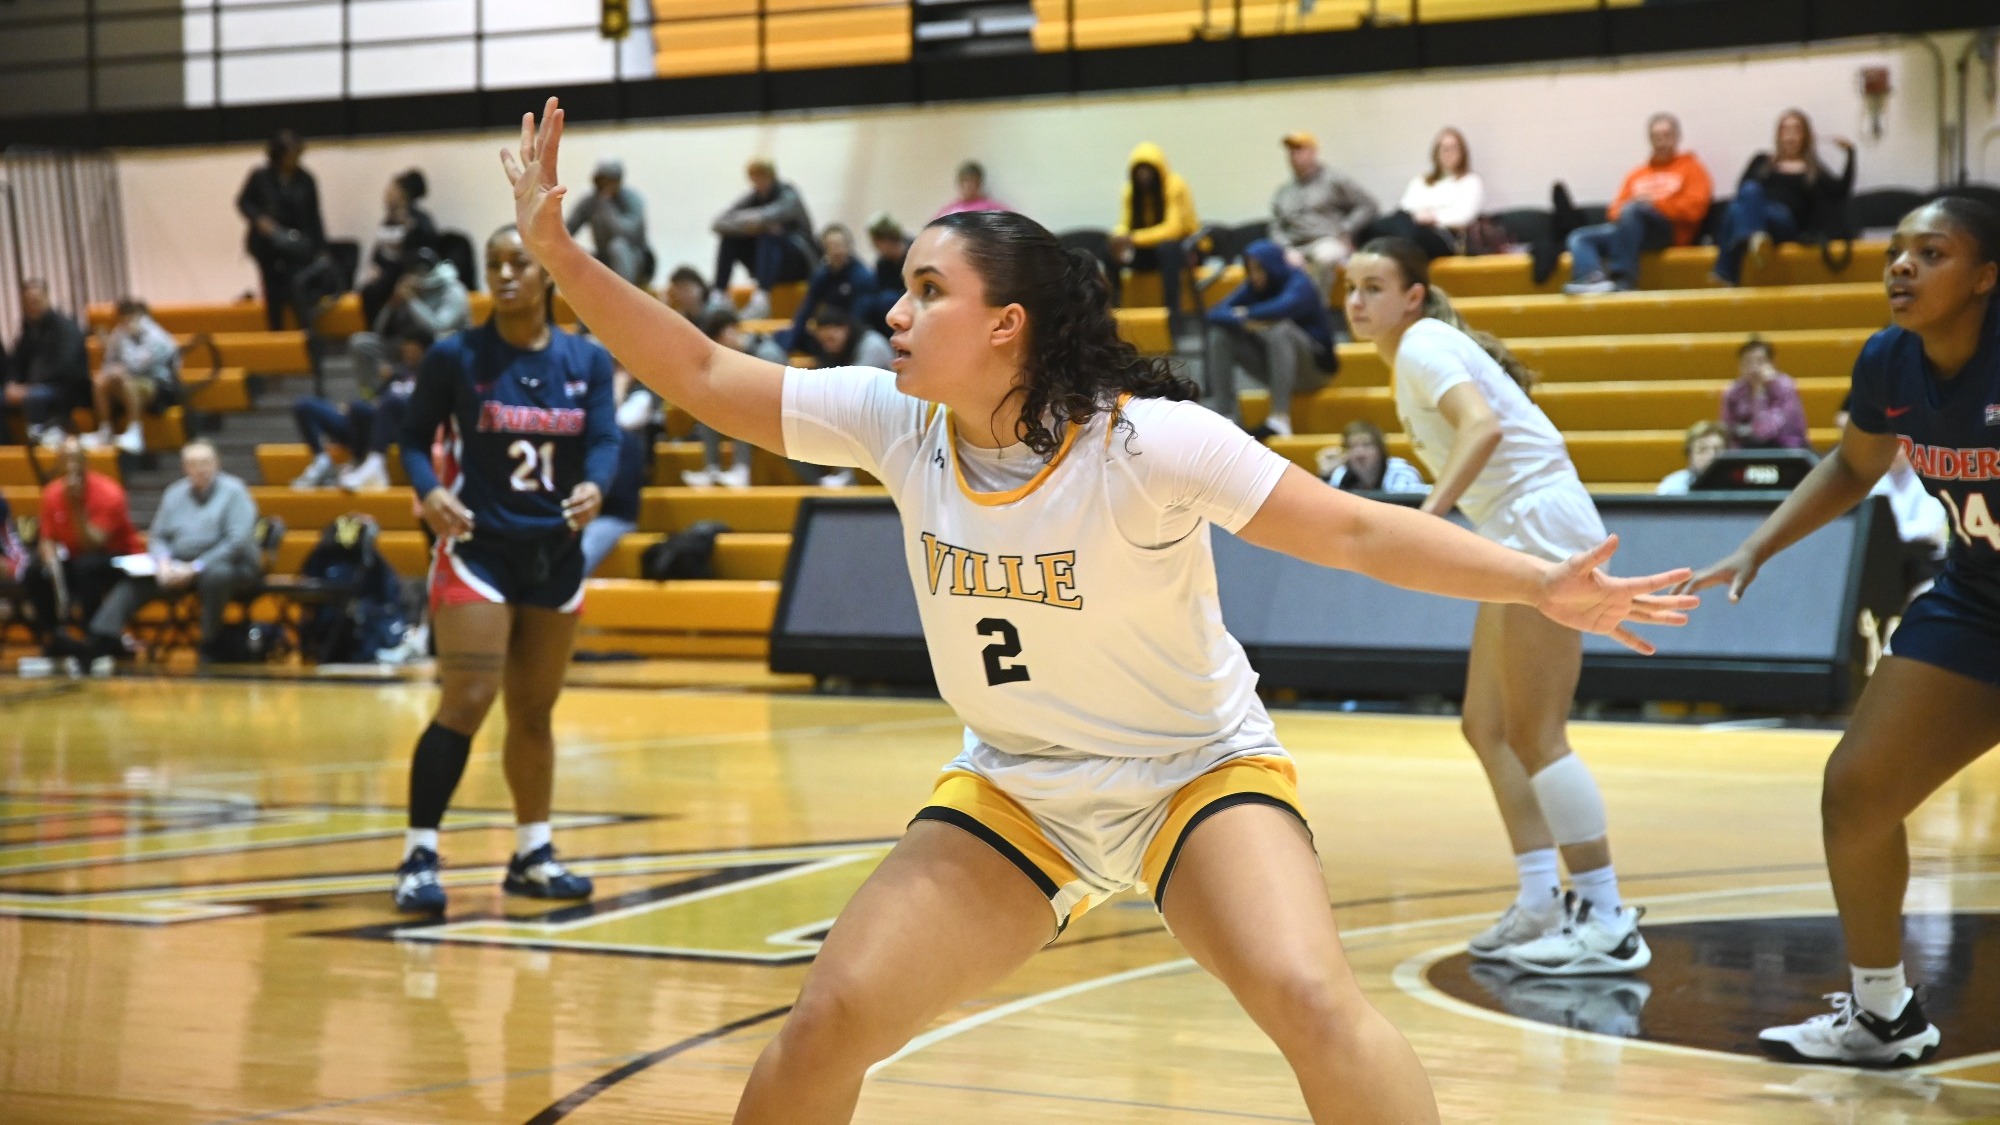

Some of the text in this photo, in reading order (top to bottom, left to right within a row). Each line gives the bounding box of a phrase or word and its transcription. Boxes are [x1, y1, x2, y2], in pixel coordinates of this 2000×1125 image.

[478, 400, 586, 435] RAIDERS
[507, 439, 556, 492] 21
[1896, 434, 2000, 481] RAIDER
[921, 531, 1083, 610] VILLE
[976, 617, 1031, 686] 2
